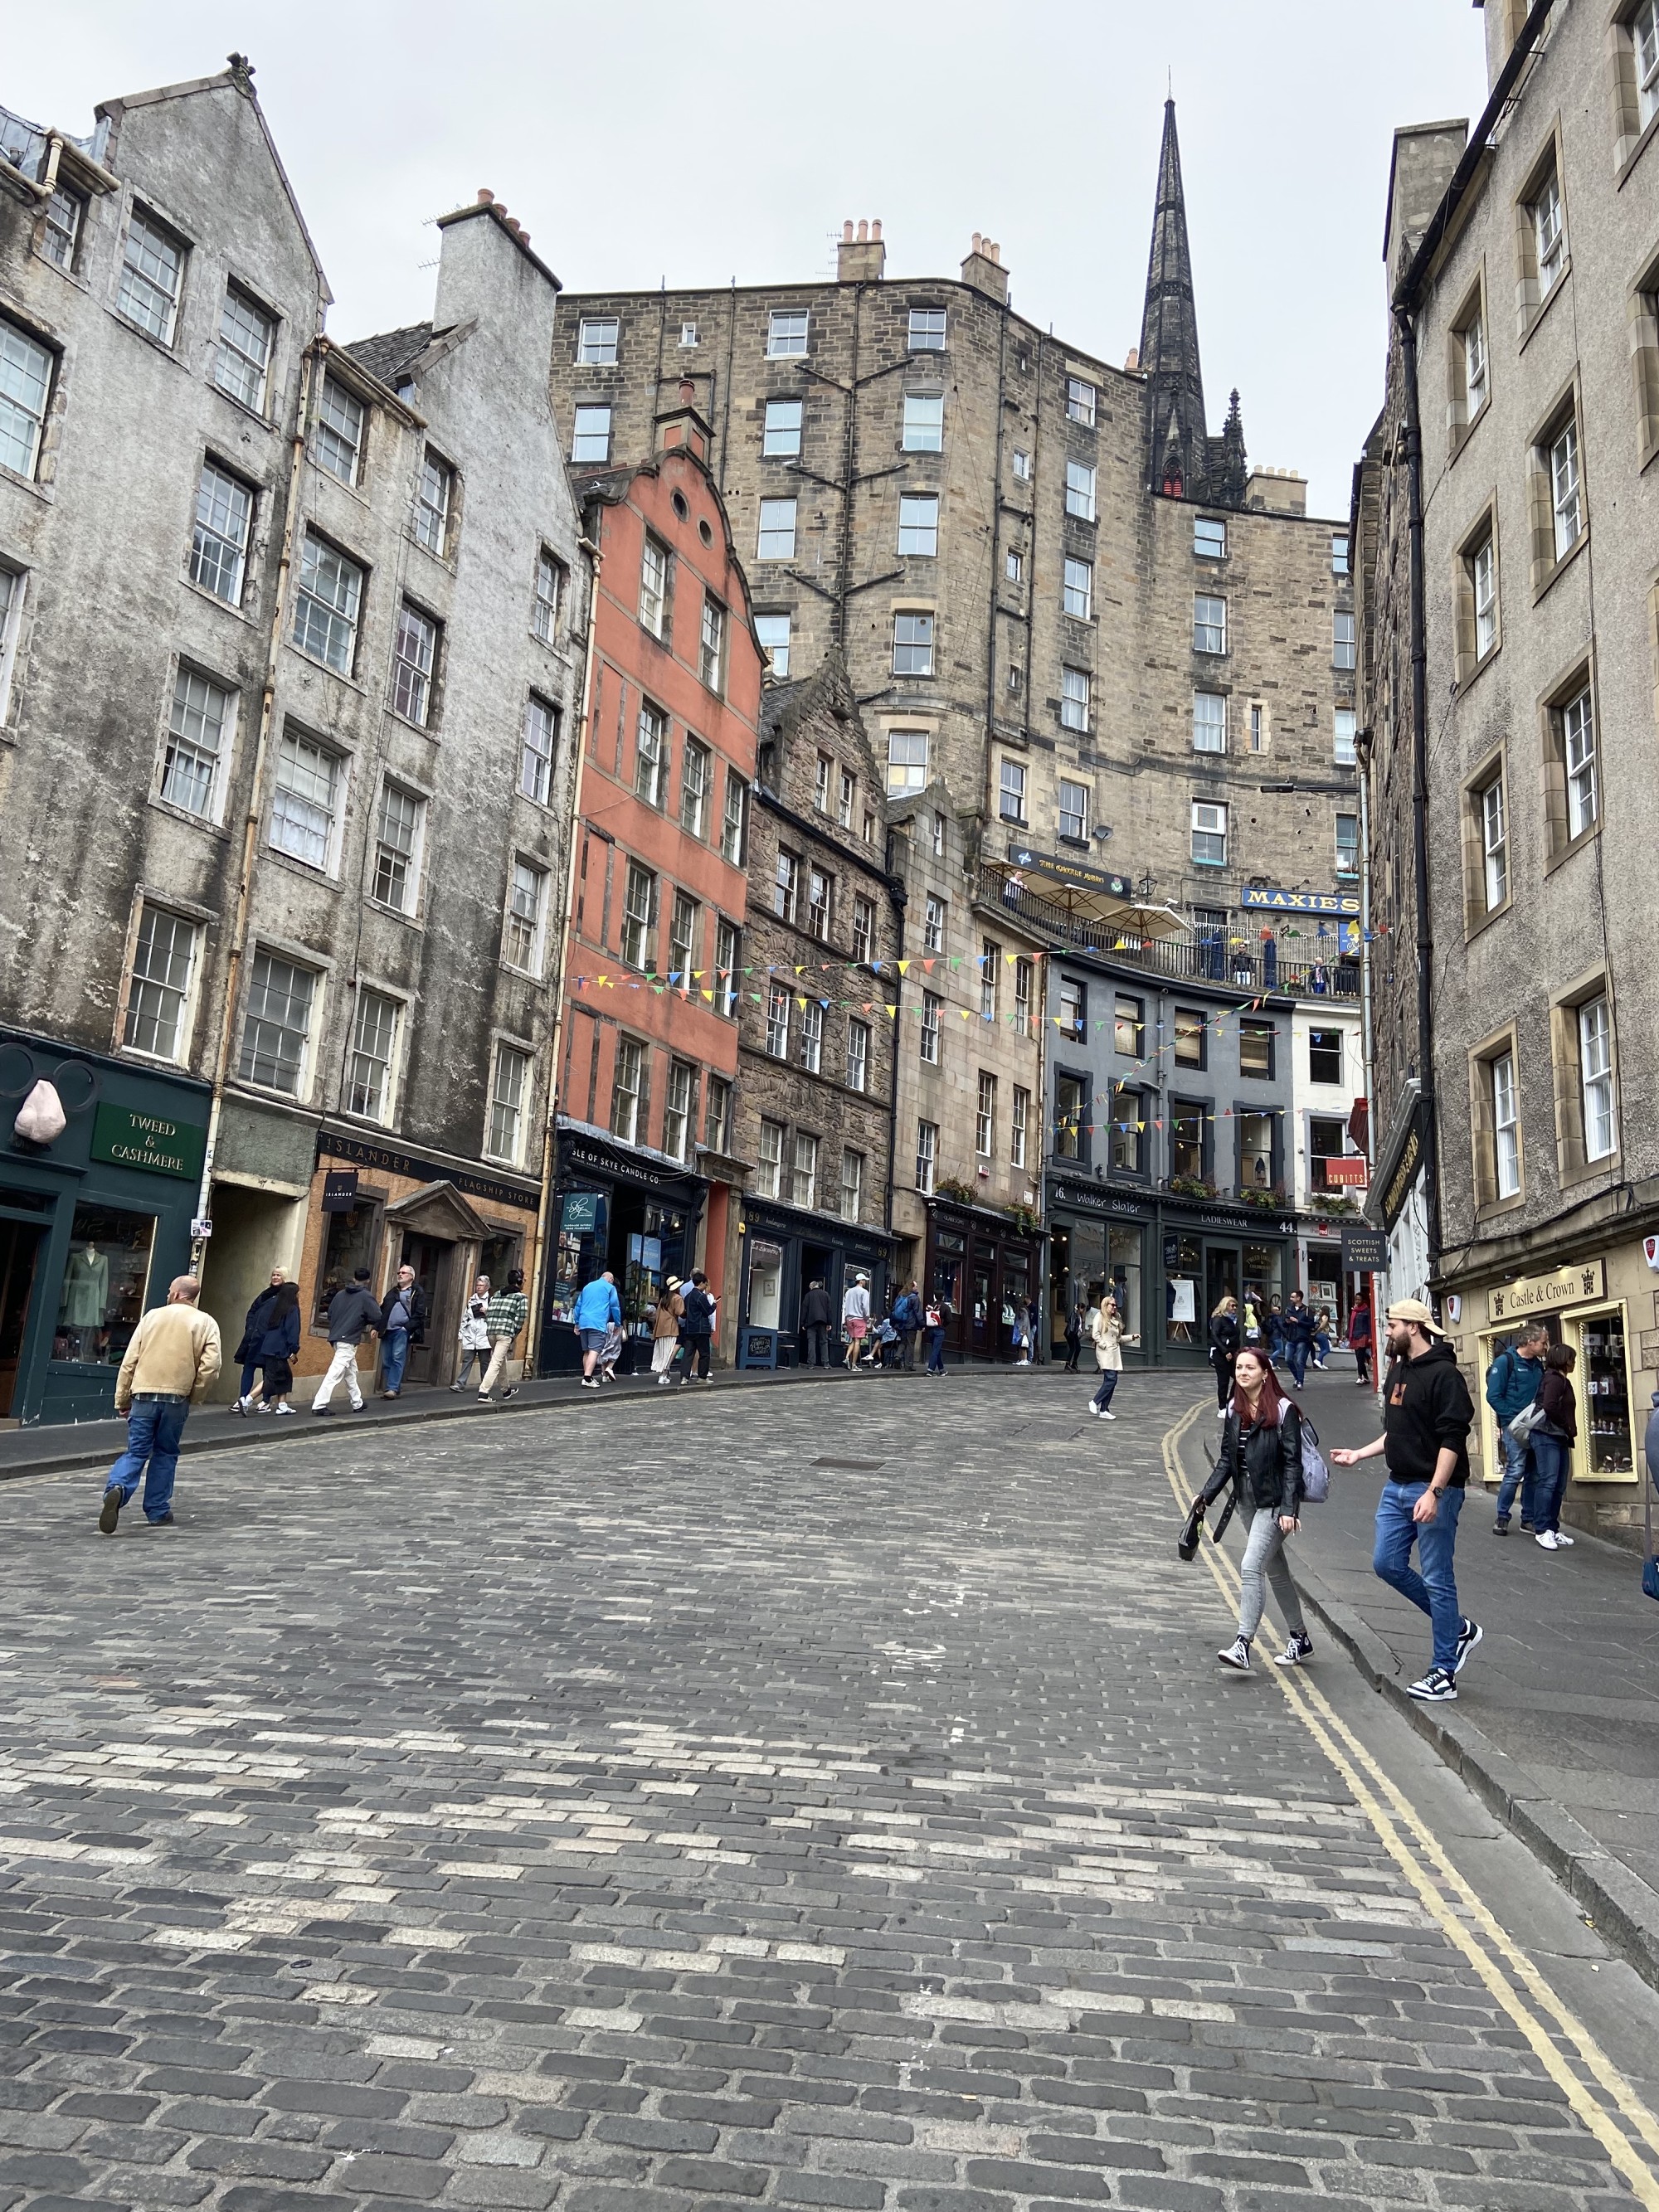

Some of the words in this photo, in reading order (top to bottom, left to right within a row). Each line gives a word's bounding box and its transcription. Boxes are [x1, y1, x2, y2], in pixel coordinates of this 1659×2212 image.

[1247, 891, 1360, 912] MAXIES
[129, 1114, 177, 1136] TWEED
[145, 1135, 156, 1148] &
[111, 1144, 184, 1171] CASHMERE
[326, 1137, 411, 1171] ISLANDER
[572, 1149, 586, 1159] SLE
[587, 1153, 598, 1163] OF
[600, 1157, 619, 1170] SKYE
[620, 1164, 647, 1180] CANDLE
[649, 1175, 661, 1185] CO.
[1328, 1174, 1364, 1184] CUBITTS
[459, 1177, 504, 1197] FLAGSHIP
[508, 1191, 534, 1205] STORE
[1077, 1193, 1107, 1208] Walker
[1112, 1199, 1141, 1213] Slater
[748, 1211, 760, 1223] 89
[1200, 1214, 1248, 1228] LADIESWEAR
[1279, 1221, 1297, 1233] 44.
[1510, 1288, 1535, 1309] Castle
[1535, 1285, 1544, 1301] &
[1545, 1281, 1574, 1300] Crown
